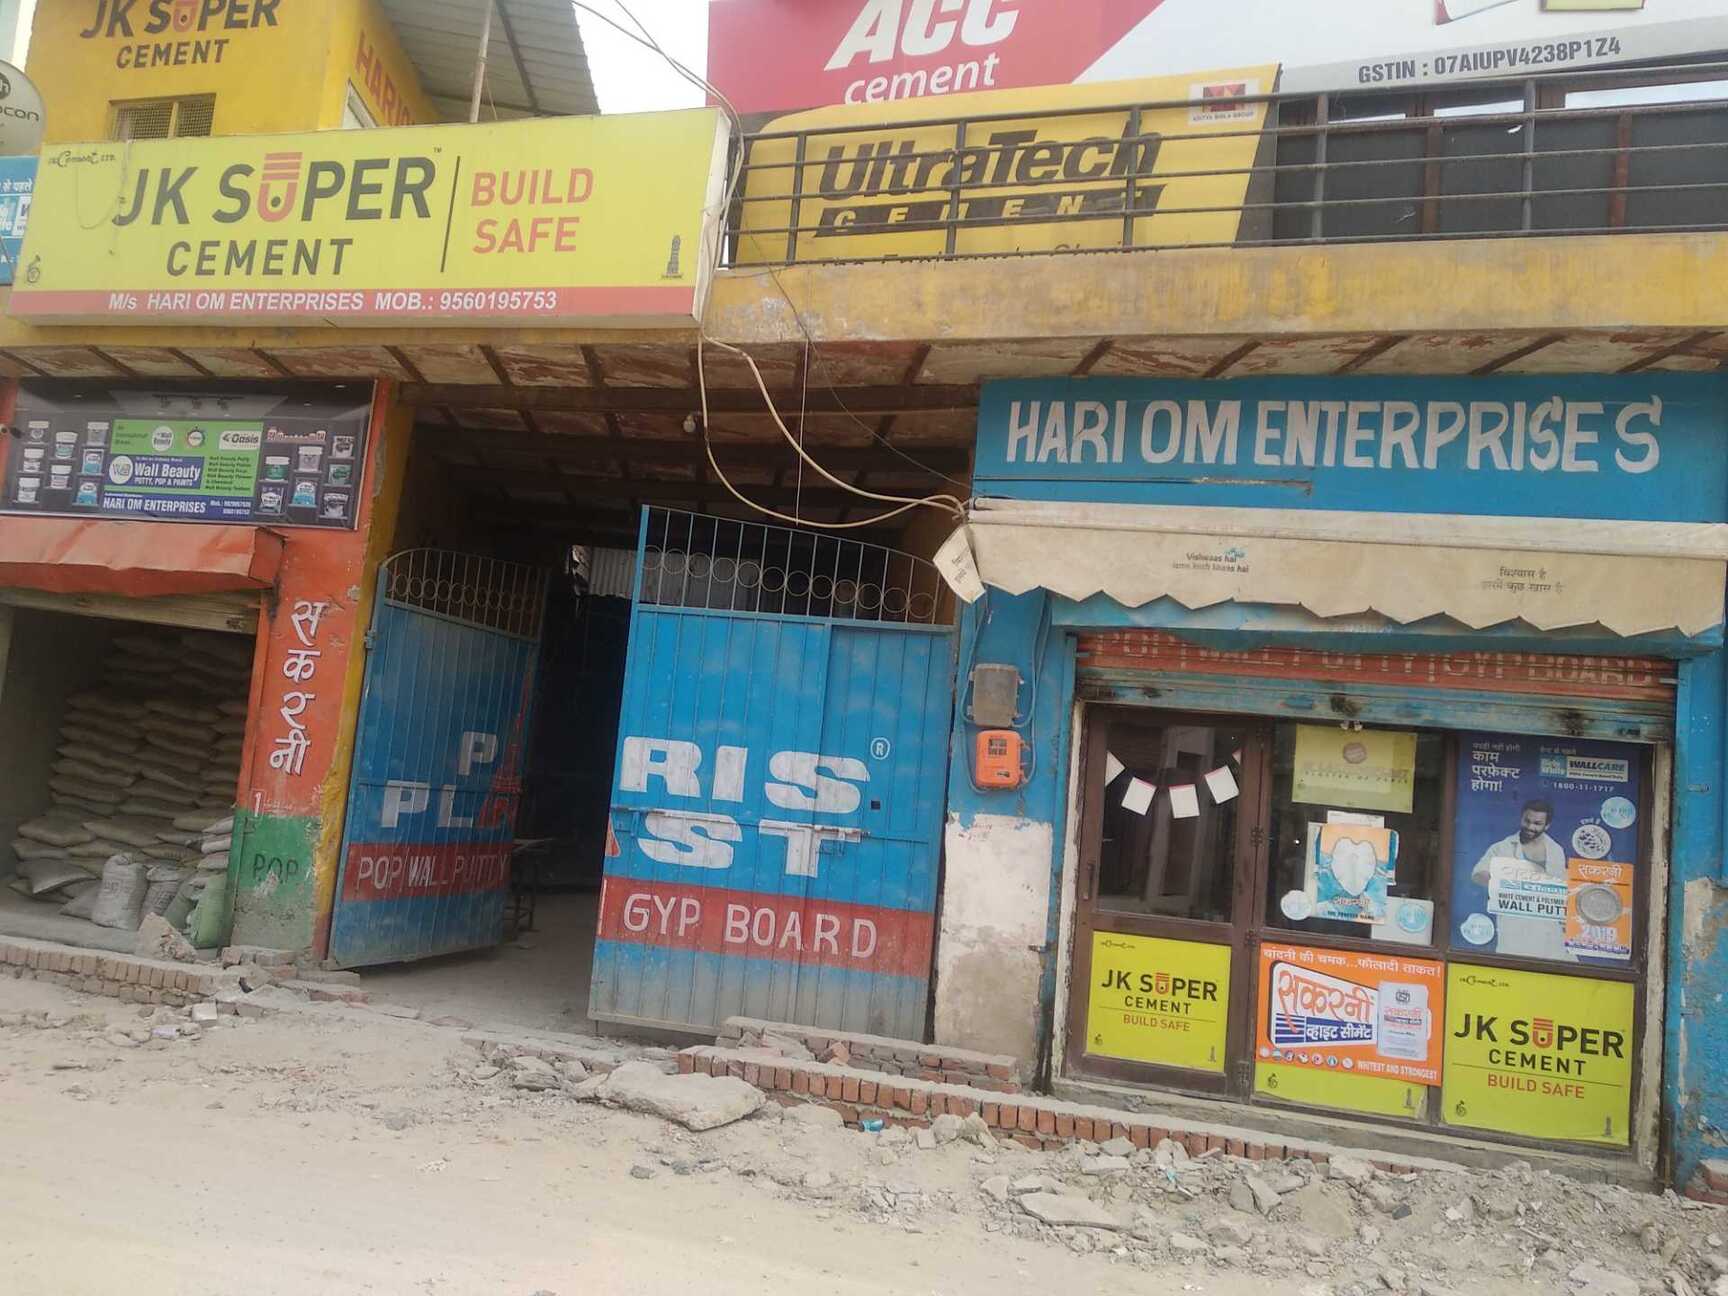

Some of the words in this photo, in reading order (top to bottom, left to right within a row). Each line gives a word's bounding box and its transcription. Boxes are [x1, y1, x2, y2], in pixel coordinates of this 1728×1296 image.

[79, 0, 134, 38] JK
[143, 0, 281, 34] SUPER
[823, 0, 1020, 72] ACC
[115, 39, 230, 69] CEMENT
[1358, 60, 1416, 83] GSTIN
[844, 52, 1000, 105] cement
[819, 120, 1162, 201] UltraTech
[111, 166, 199, 226] JK
[211, 151, 437, 224] SUPER
[470, 168, 594, 207] BUILD
[473, 216, 579, 254] SAFE
[167, 238, 353, 277] CEMENT
[108, 293, 138, 310] M/s
[147, 293, 191, 310] HARI
[196, 293, 225, 310] OM
[230, 291, 364, 311] ENTERPRISES
[439, 290, 558, 310] 9560195753
[1005, 400, 1127, 464] HARI
[1140, 400, 1242, 465] OM
[1253, 396, 1664, 474] ENTERPRISES
[134, 462, 159, 477] Wall
[161, 464, 201, 482] Beauty
[103, 497, 125, 510] HARI
[127, 499, 143, 511] OM
[144, 500, 207, 514] ENTERPRISES
[458, 731, 498, 777] P
[1472, 750, 1500, 762] काम
[618, 736, 871, 814] RIS
[623, 893, 701, 937] GYP
[724, 903, 877, 958] BOARD
[1498, 899, 1533, 913] WALL
[1537, 903, 1568, 917] PUTT
[1101, 969, 1132, 991] JK
[1139, 972, 1218, 1002] SUPER
[1123, 1014, 1158, 1028] BUILD
[1160, 1019, 1191, 1032] SAFE
[1124, 995, 1193, 1015] CEMENT
[1453, 1013, 1499, 1043] JK
[1509, 1016, 1625, 1059] SUPER
[1488, 1048, 1587, 1076] CEMENT
[1487, 1072, 1537, 1093] BUILD
[1541, 1081, 1586, 1100] SAFE
